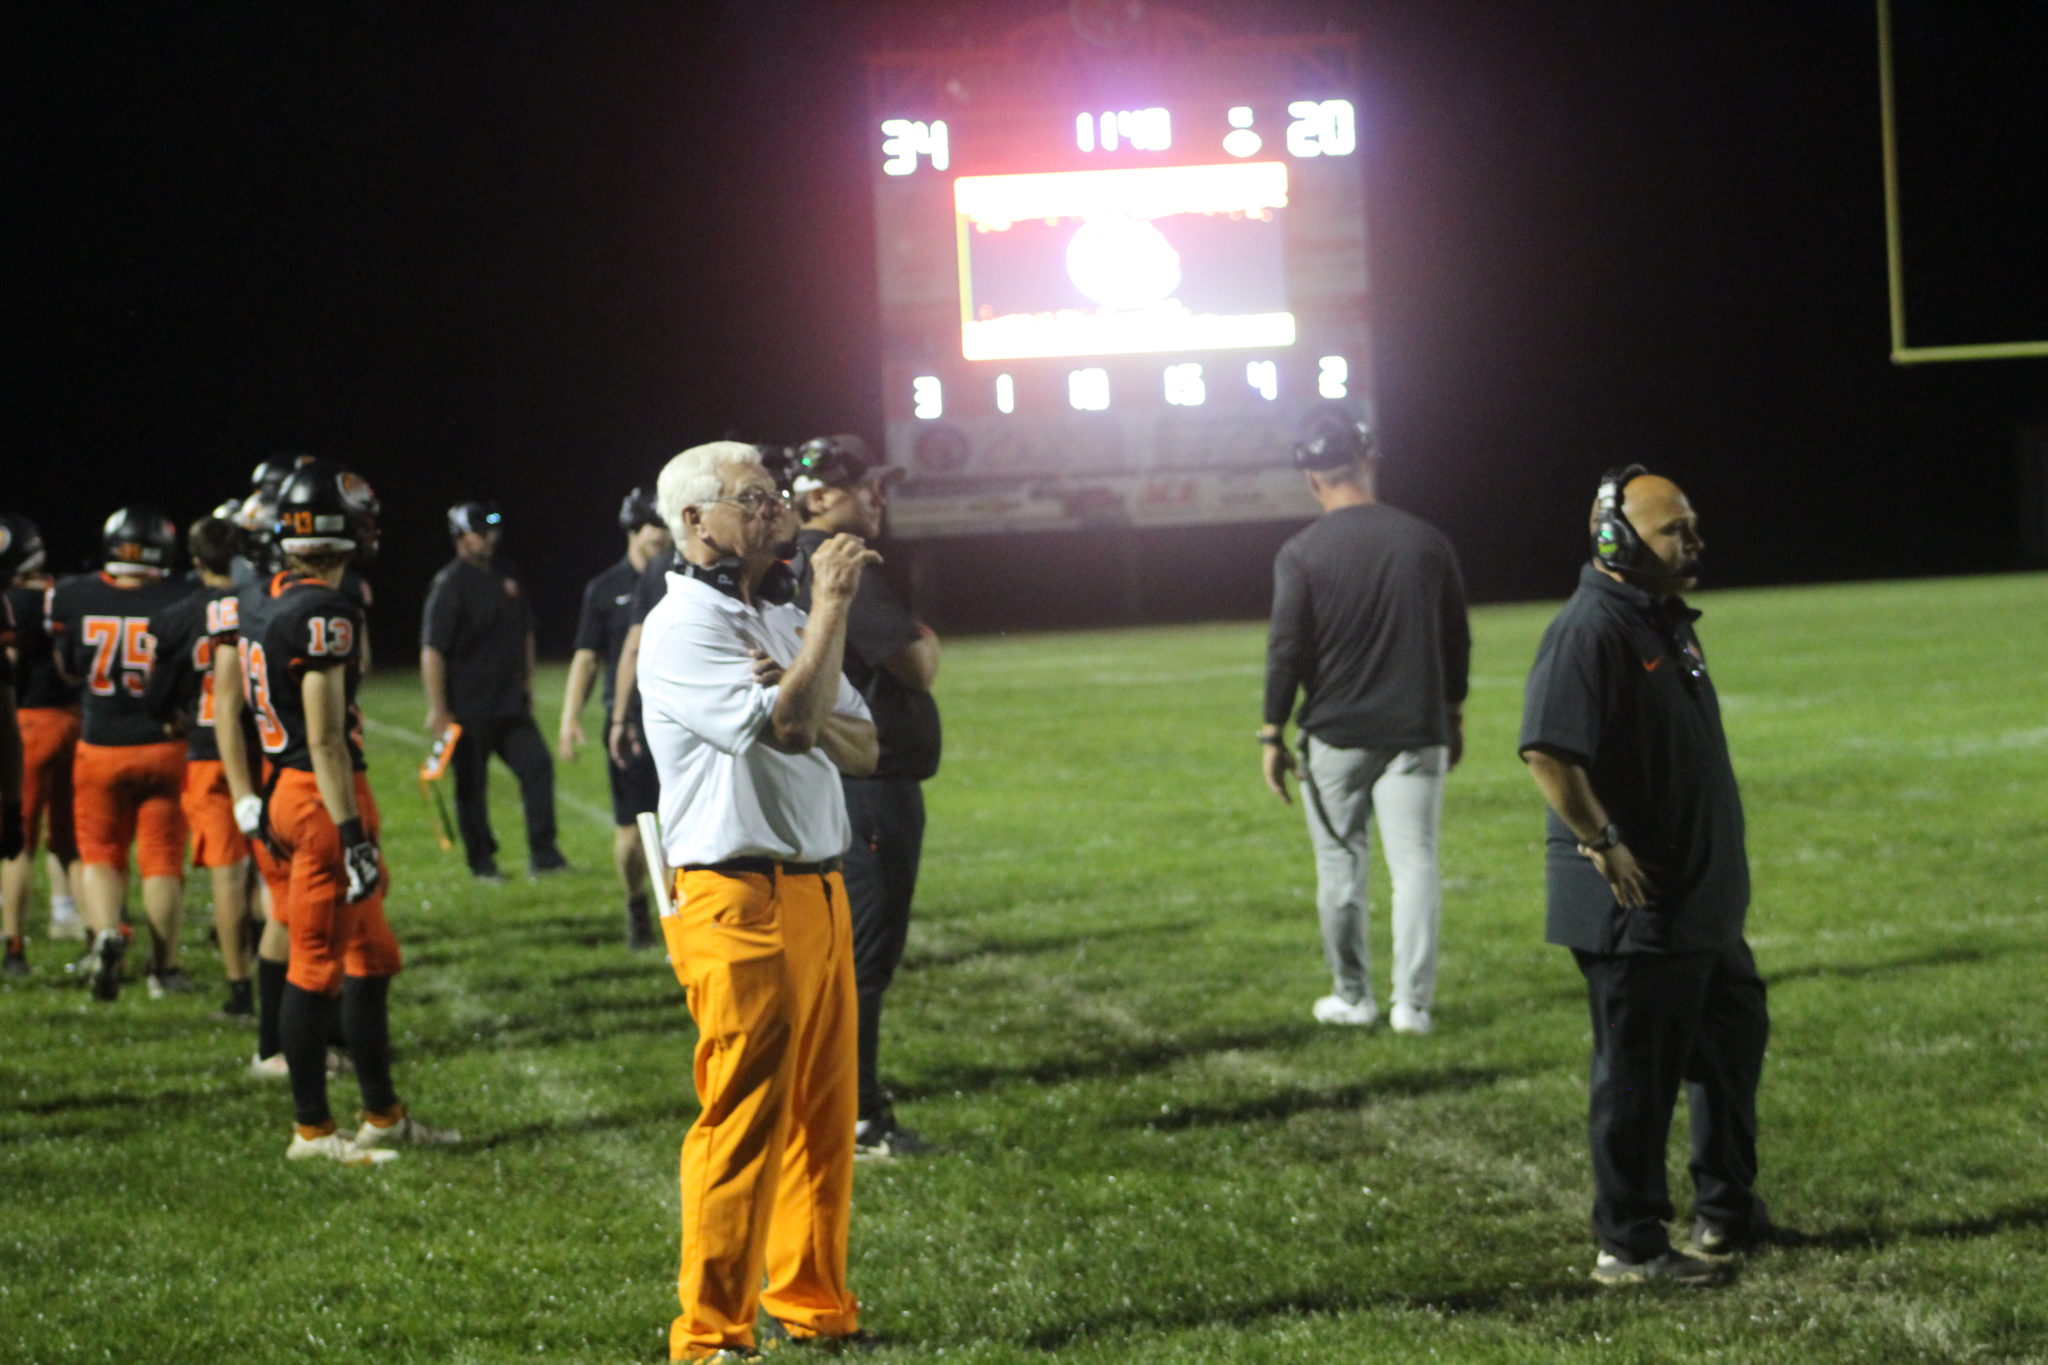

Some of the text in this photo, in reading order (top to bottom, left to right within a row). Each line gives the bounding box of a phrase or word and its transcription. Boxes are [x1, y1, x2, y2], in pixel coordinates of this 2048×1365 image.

[881, 119, 949, 176] 34
[1287, 100, 1355, 157] 20
[914, 376, 943, 419] 3
[996, 373, 1014, 414] 1
[1247, 361, 1277, 400] 4
[1318, 355, 1347, 399] 2
[83, 615, 157, 697] 75
[306, 616, 353, 656] 13
